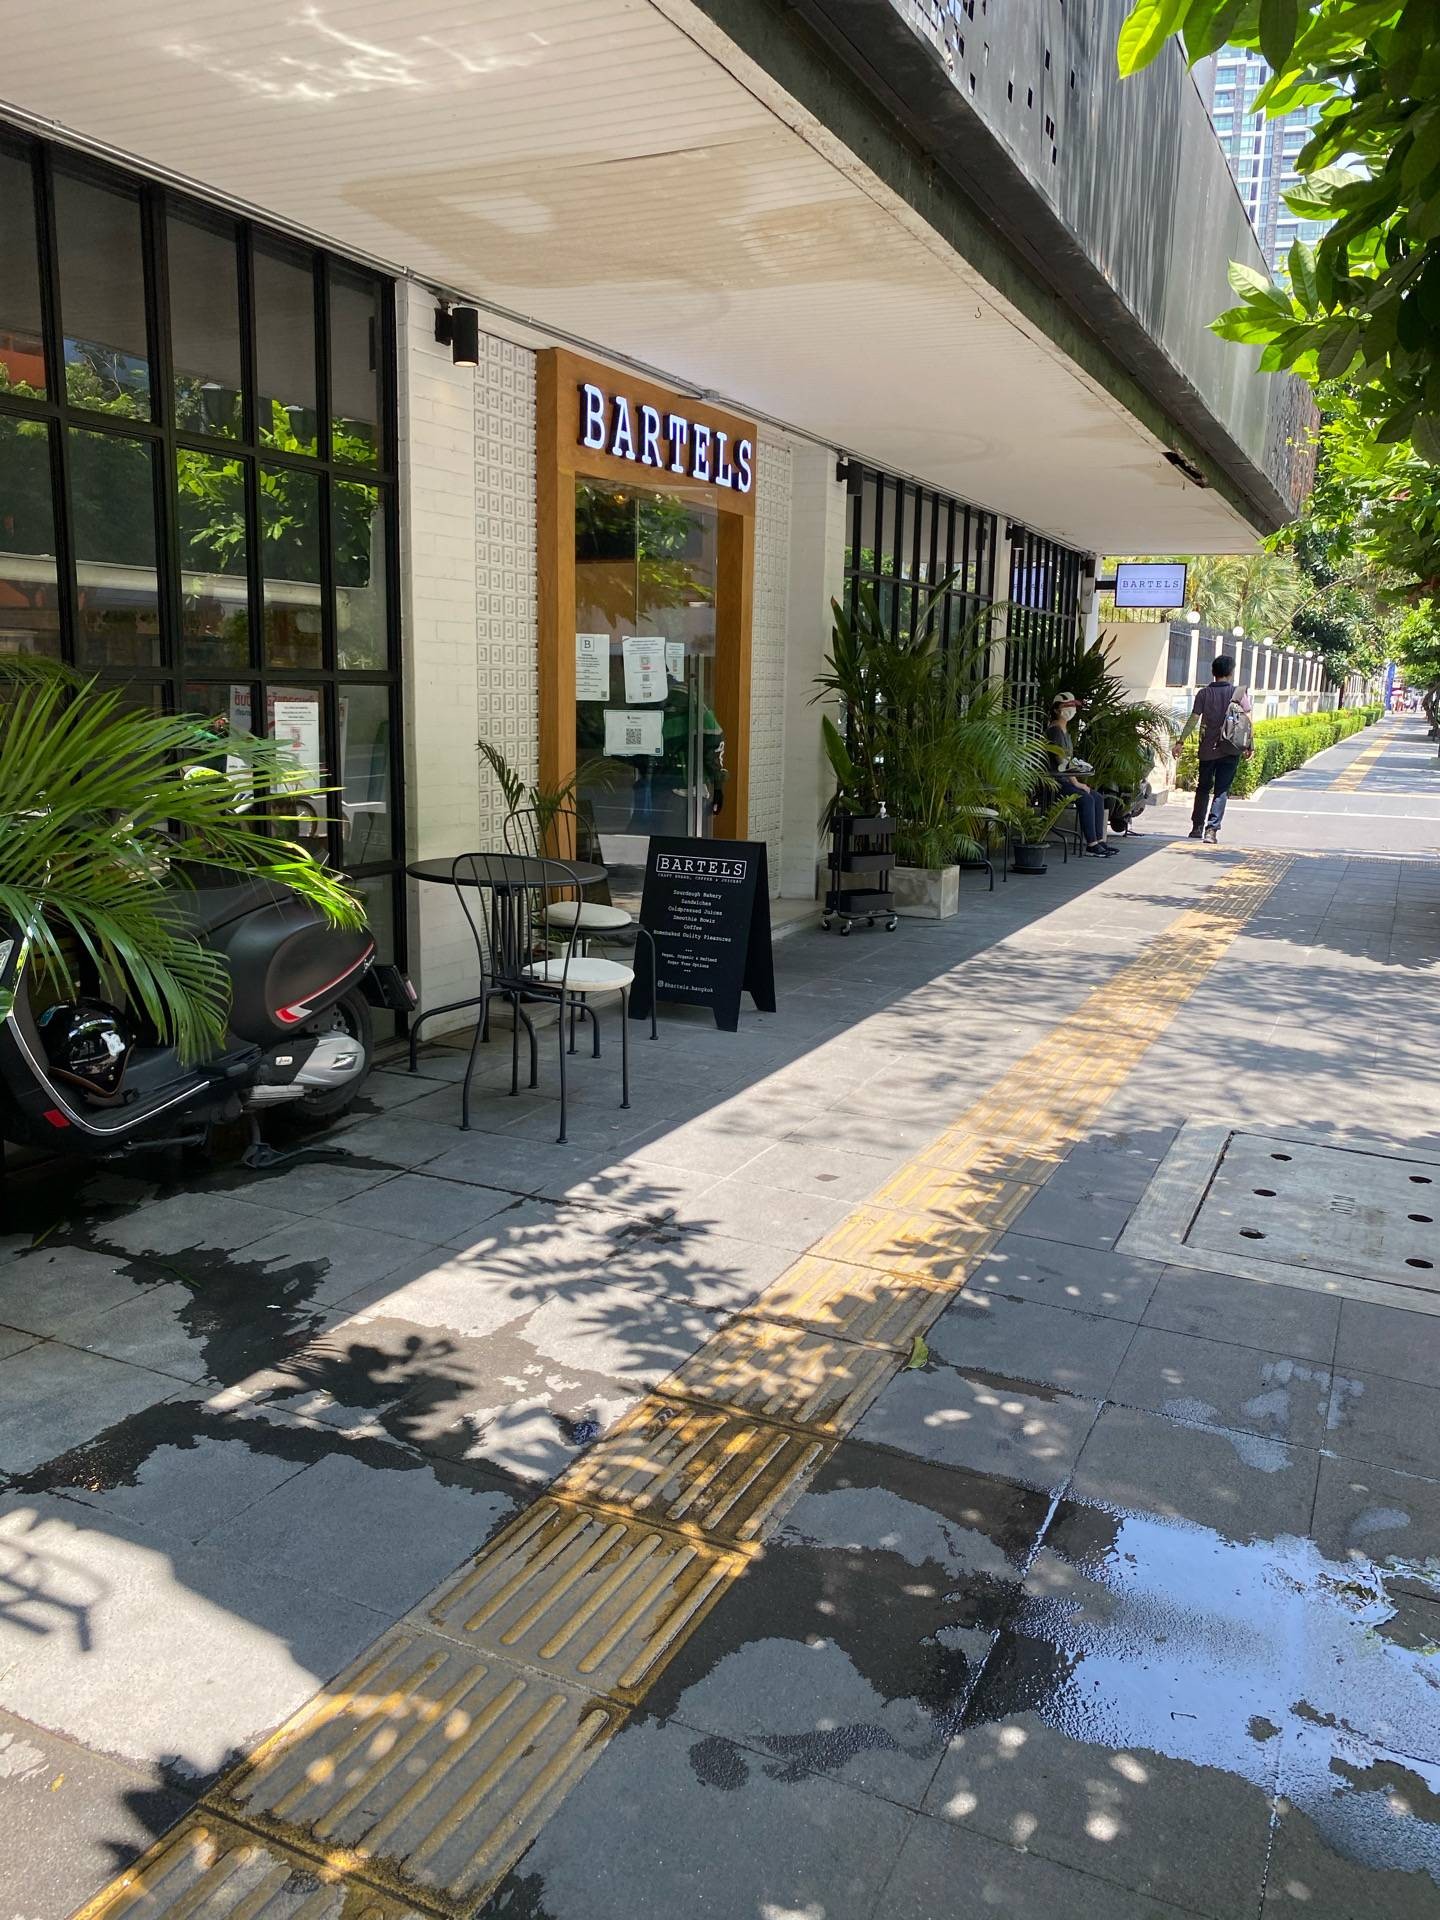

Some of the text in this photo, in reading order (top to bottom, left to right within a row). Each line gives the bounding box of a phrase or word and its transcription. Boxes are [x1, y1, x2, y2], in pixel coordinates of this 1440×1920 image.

[582, 383, 752, 493] BARTELS
[1122, 580, 1179, 588] BARTELS
[584, 640, 591, 649] B
[660, 857, 743, 876] BARTELS
[673, 889, 722, 900] Sourdough Bakery
[681, 898, 712, 906] Sandwiches
[667, 905, 723, 916] Coldpressed Juices
[673, 914, 697, 922] Smoothie
[683, 923, 702, 931] Coffee
[703, 934, 732, 943] Pleasures
